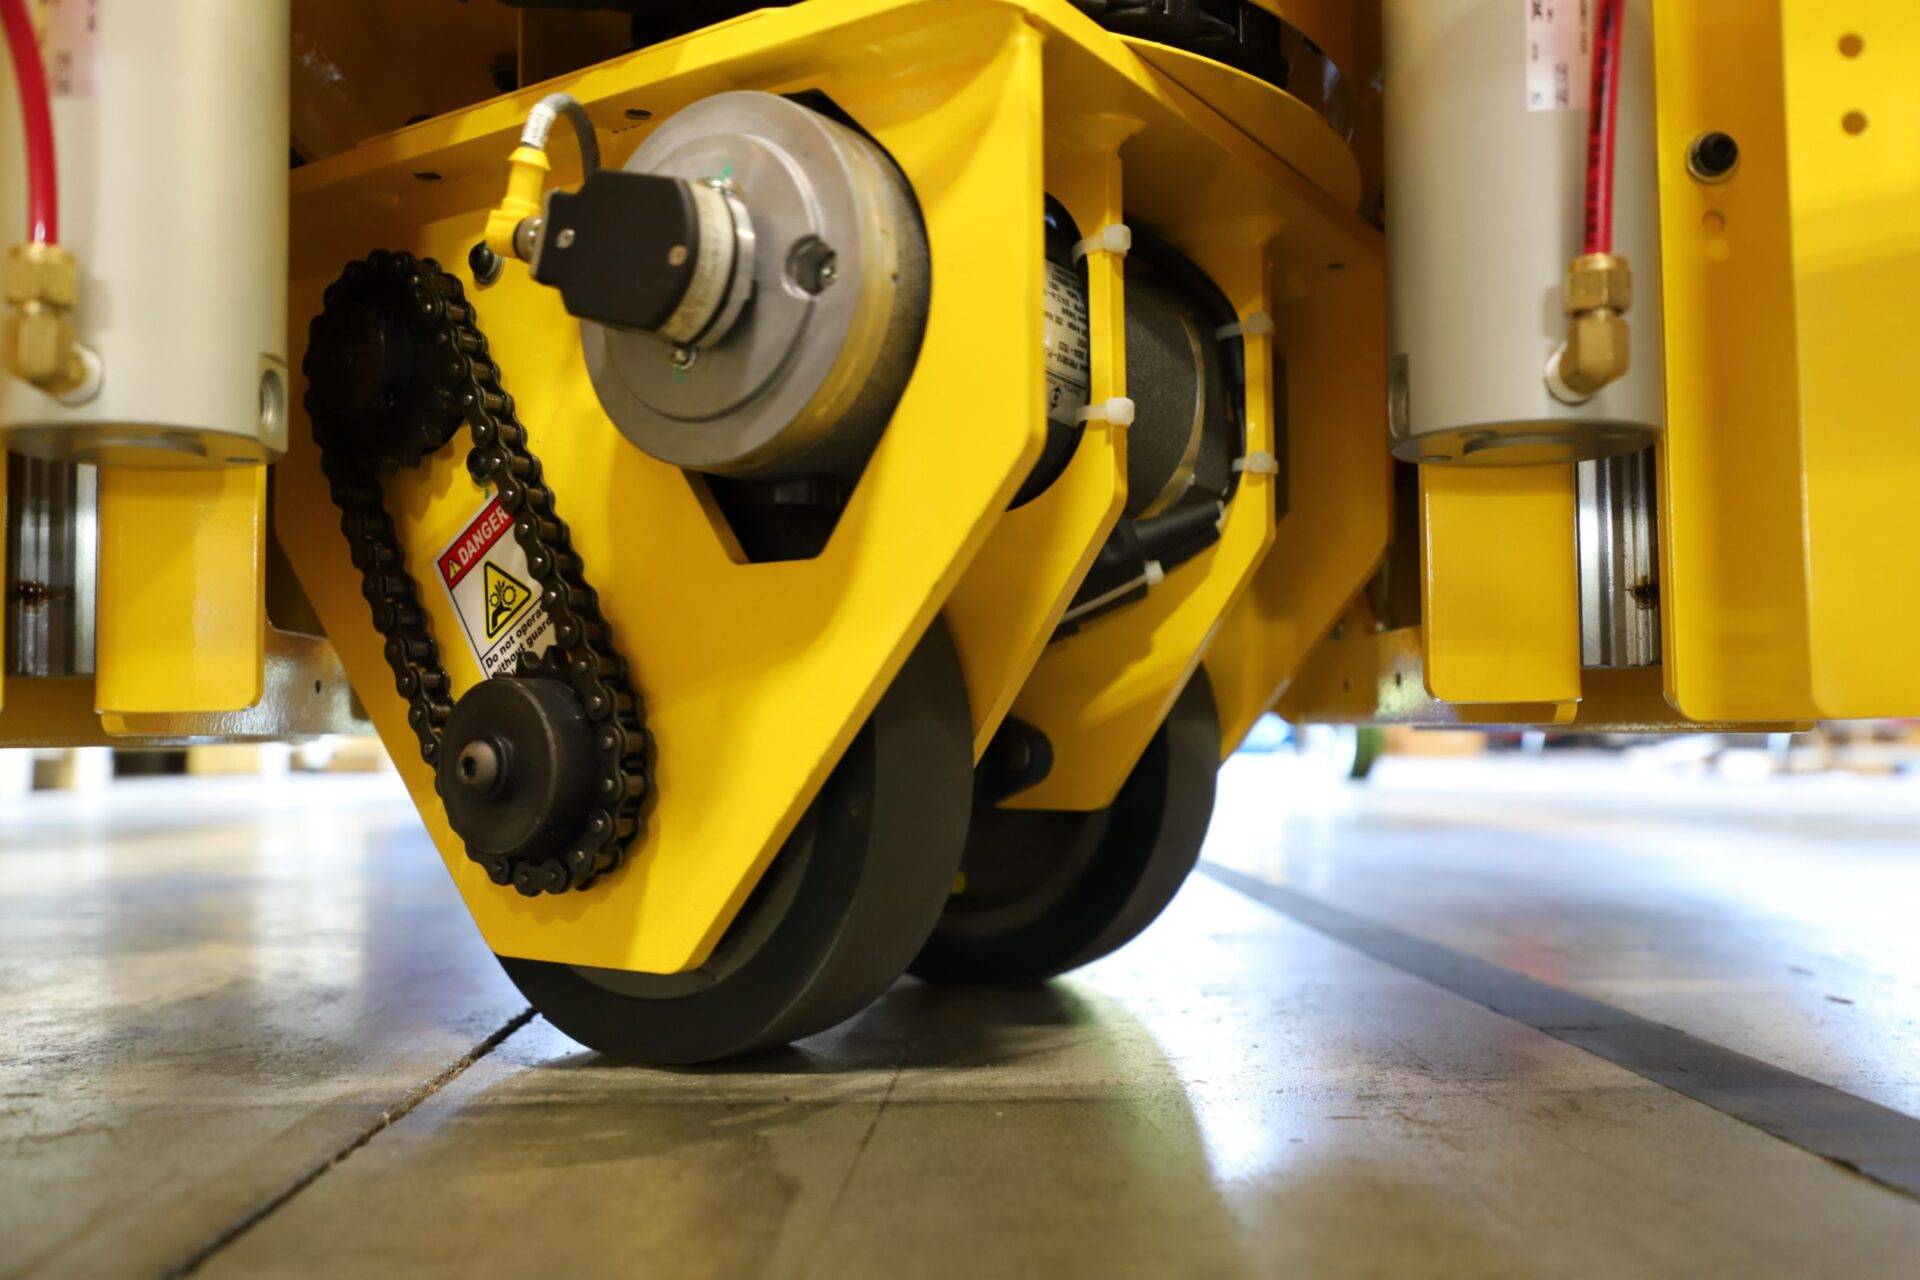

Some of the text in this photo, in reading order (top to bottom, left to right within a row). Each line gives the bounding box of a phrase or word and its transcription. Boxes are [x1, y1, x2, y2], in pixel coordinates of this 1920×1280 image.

[457, 505, 509, 565] DANGER
[485, 604, 545, 669] Do not operat
[496, 642, 526, 674] ithout
